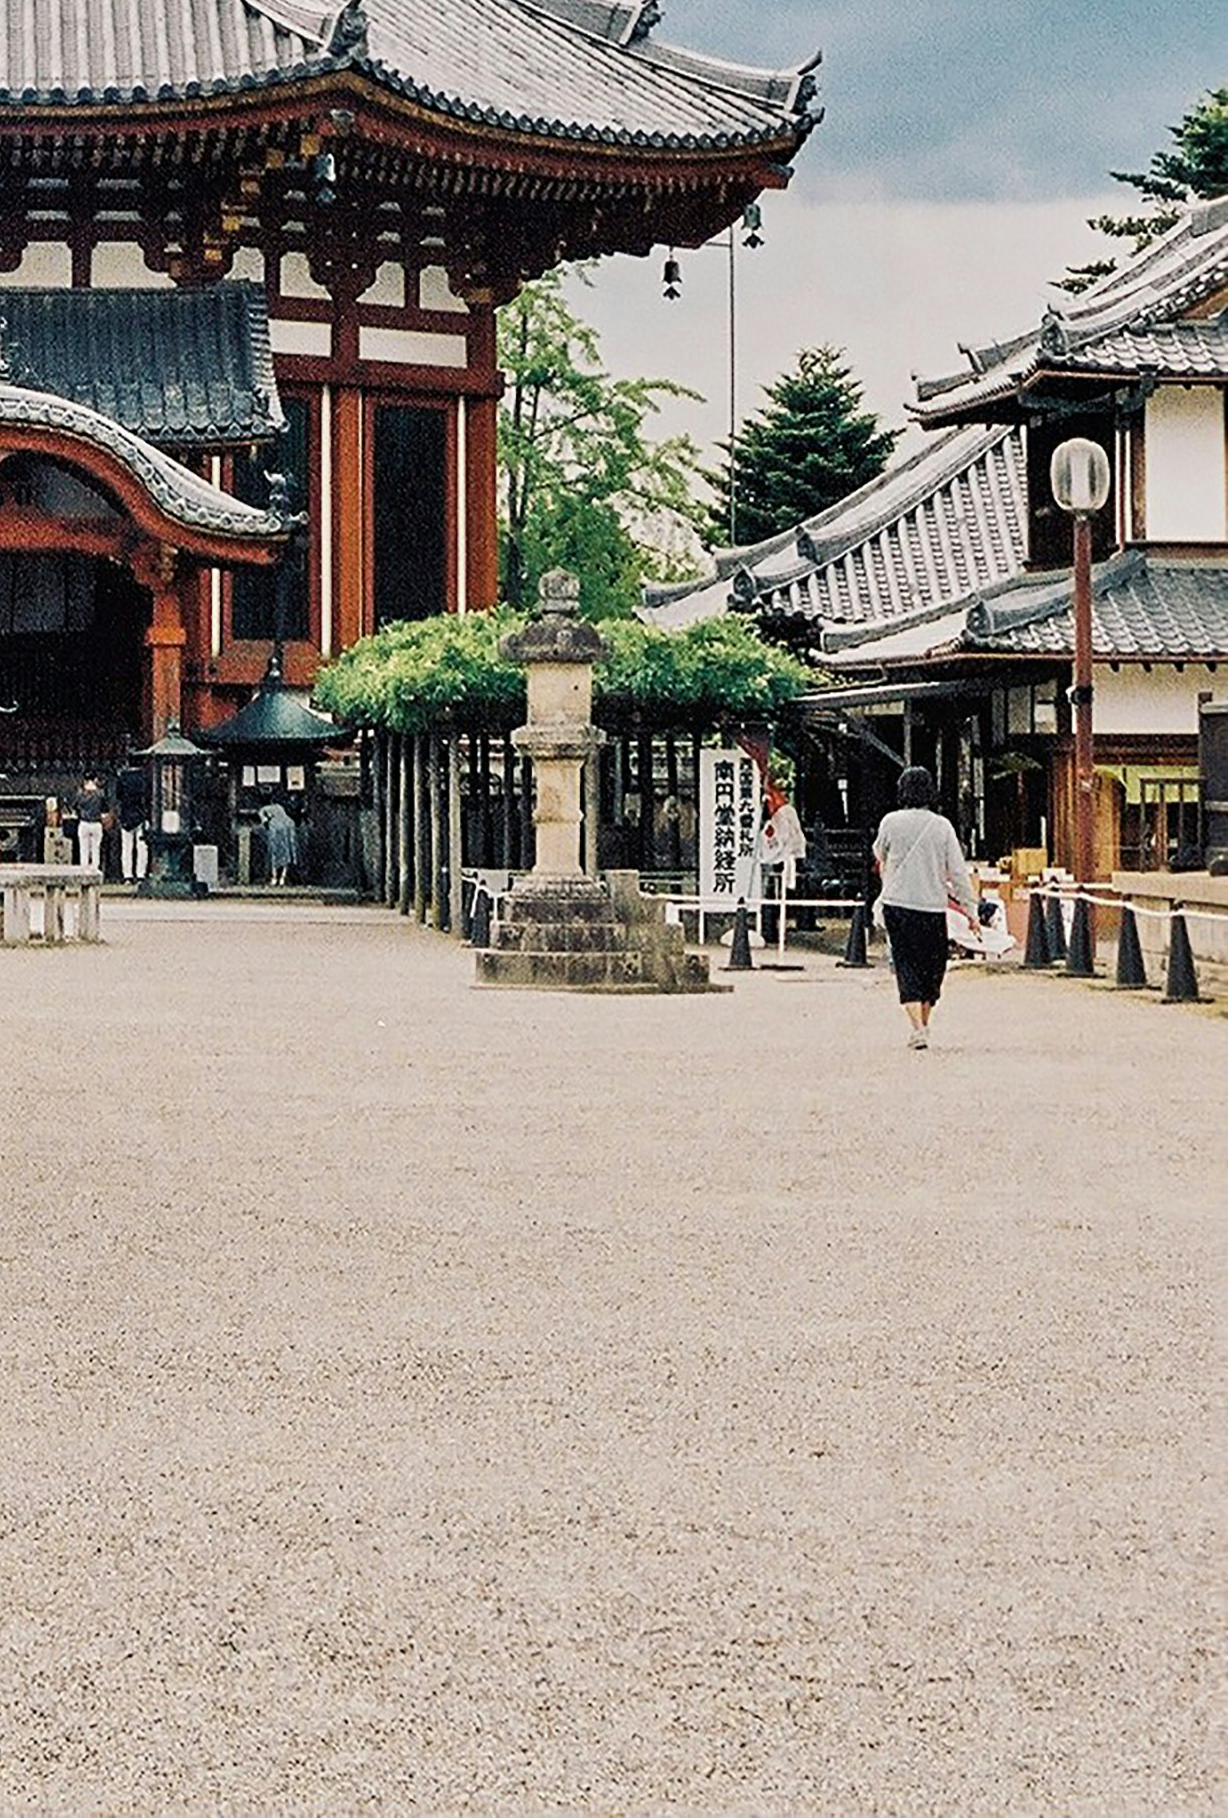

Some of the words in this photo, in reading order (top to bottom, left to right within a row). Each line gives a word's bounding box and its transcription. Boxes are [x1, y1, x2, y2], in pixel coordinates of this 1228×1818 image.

[713, 759, 736, 894] 南円堂納経所
